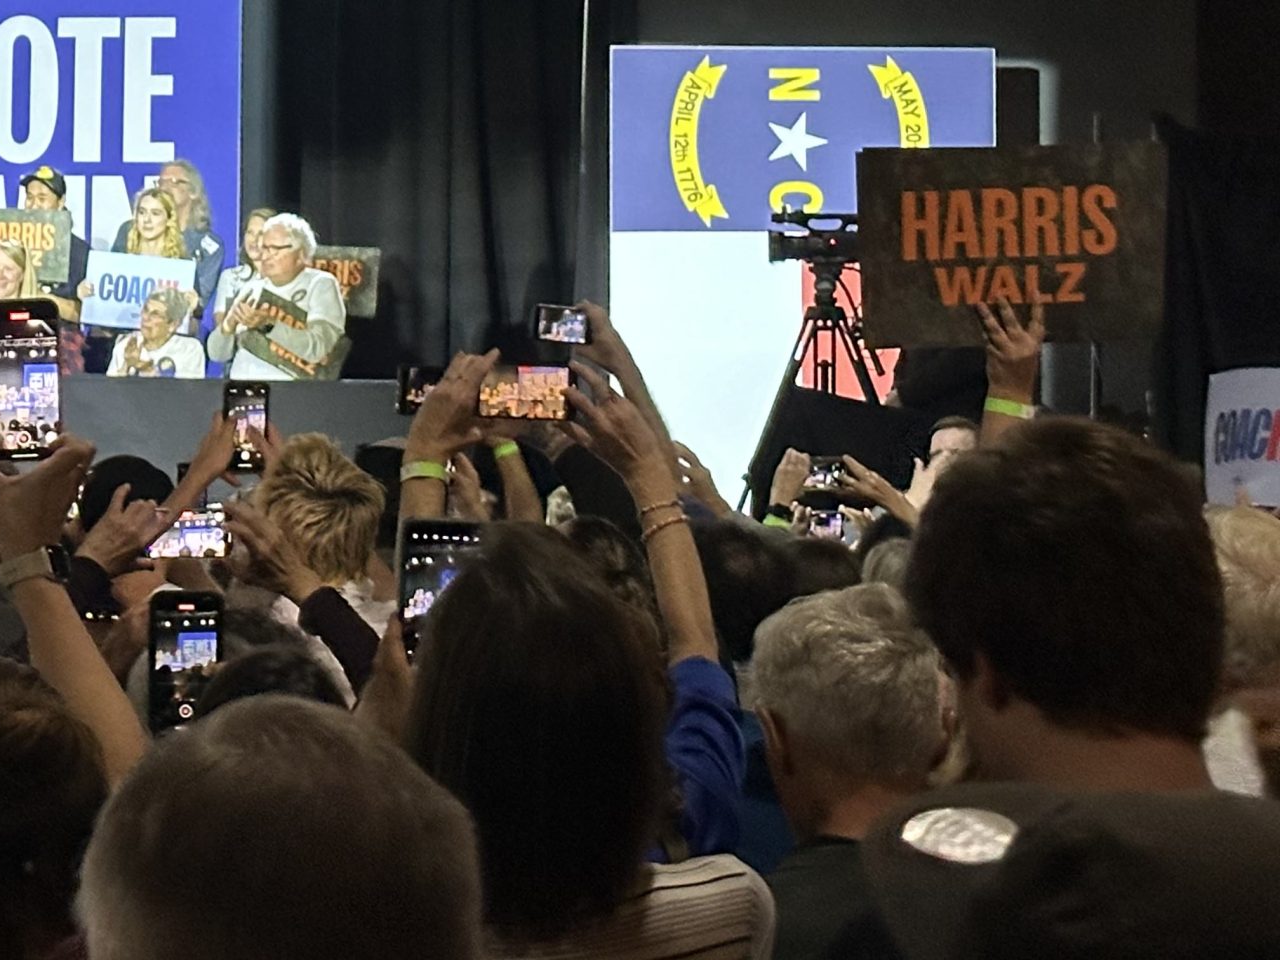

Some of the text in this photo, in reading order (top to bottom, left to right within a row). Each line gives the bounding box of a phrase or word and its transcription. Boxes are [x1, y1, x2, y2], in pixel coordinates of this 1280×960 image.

[768, 67, 820, 102] N
[674, 77, 704, 203] APRIL 12th 1776
[893, 80, 922, 146] MAY 20
[900, 183, 1118, 261] HARRIS
[98, 272, 180, 305] COAC
[934, 262, 1086, 307] WALZ
